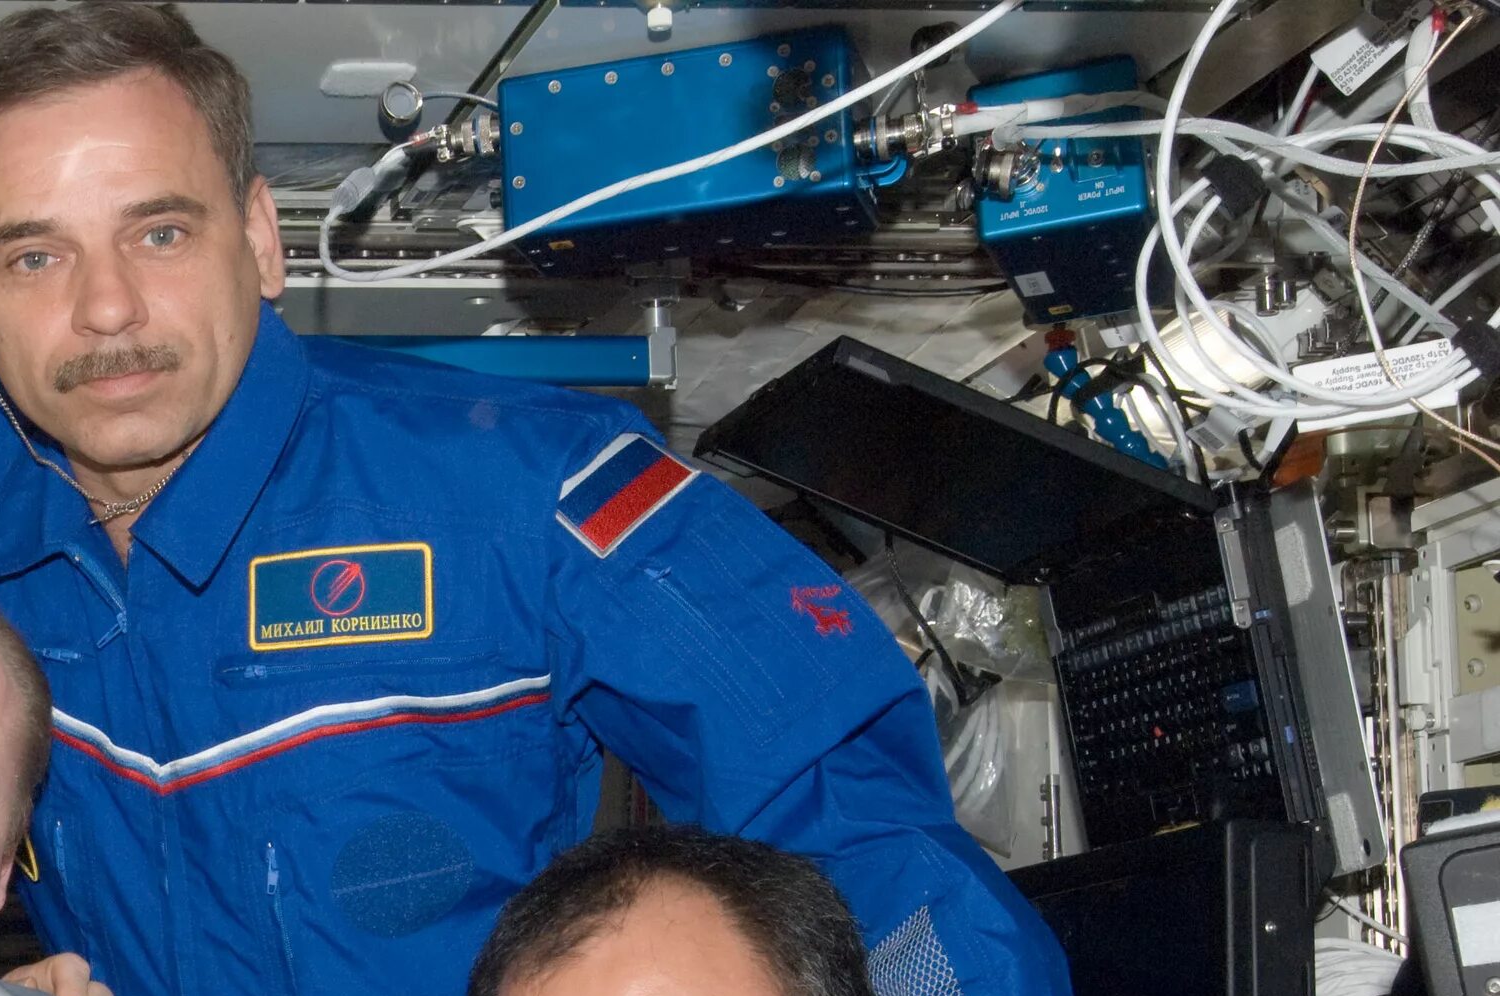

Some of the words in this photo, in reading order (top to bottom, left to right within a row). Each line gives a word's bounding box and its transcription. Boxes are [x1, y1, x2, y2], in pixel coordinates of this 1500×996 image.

[1095, 181, 1105, 189] ON
[1078, 191, 1101, 201] POWER
[1105, 186, 1125, 196] INPUT
[1000, 211, 1019, 221] INPUT
[1332, 365, 1362, 377] Supply
[261, 619, 324, 639] МИХАИЛ
[331, 613, 422, 633] КОРНИЕНКО
